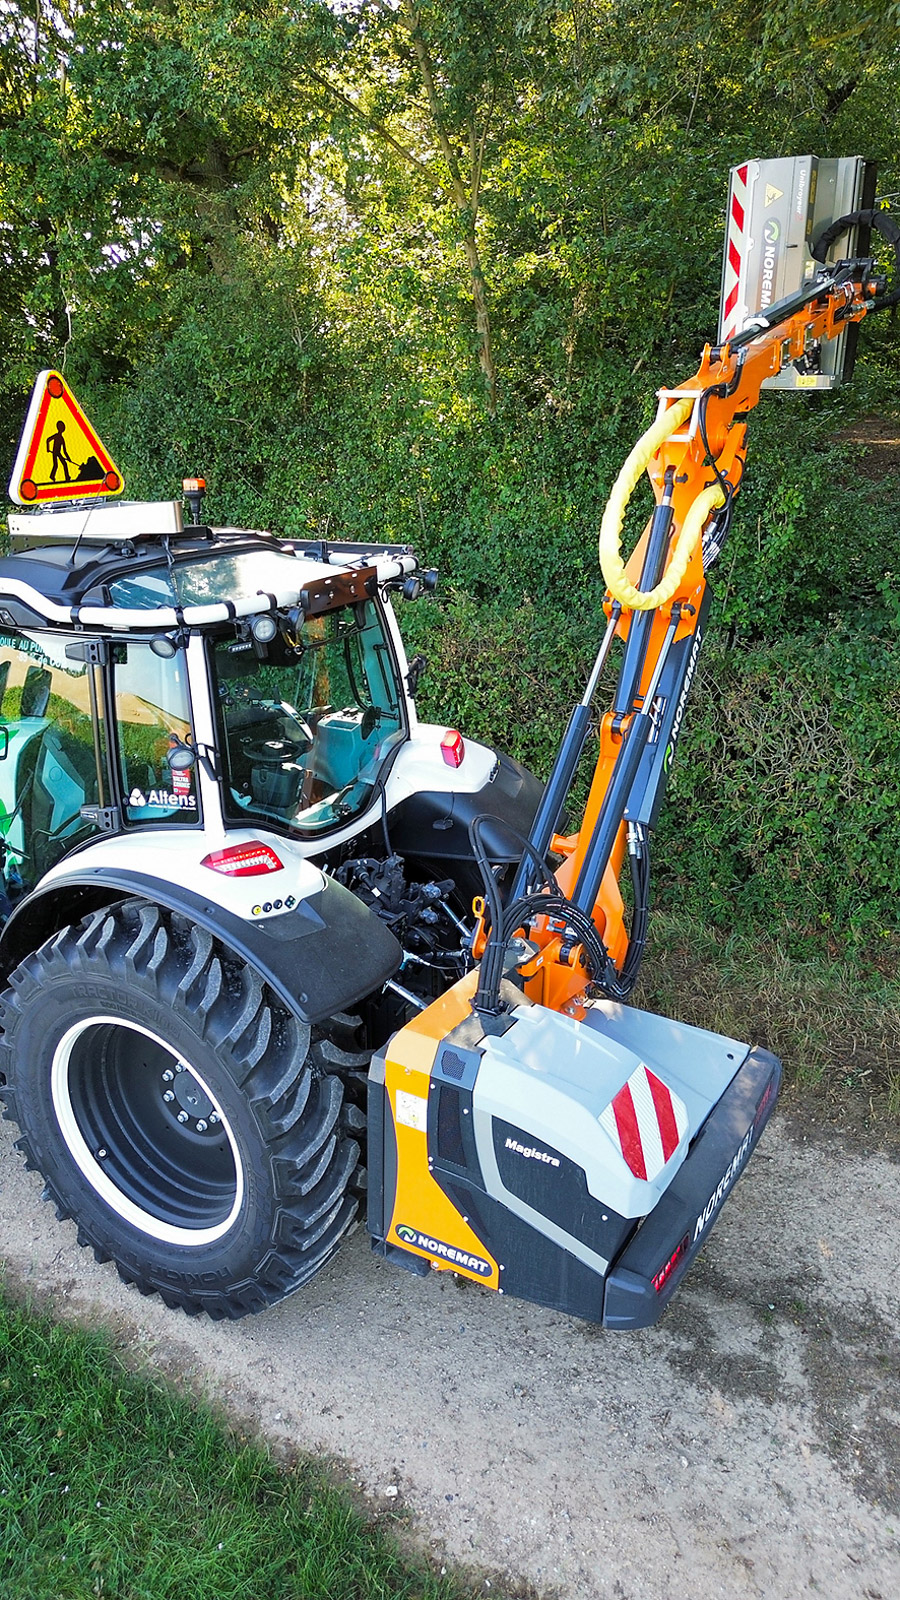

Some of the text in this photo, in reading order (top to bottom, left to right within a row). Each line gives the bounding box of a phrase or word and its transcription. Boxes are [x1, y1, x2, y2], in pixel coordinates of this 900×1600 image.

[760, 246, 776, 310] NOREM
[671, 625, 702, 741] NOREMAT
[148, 789, 196, 806] Altens
[505, 1137, 561, 1168] Magistra
[693, 1125, 755, 1243] NOREMAT
[417, 1234, 489, 1273] NOREMAT
